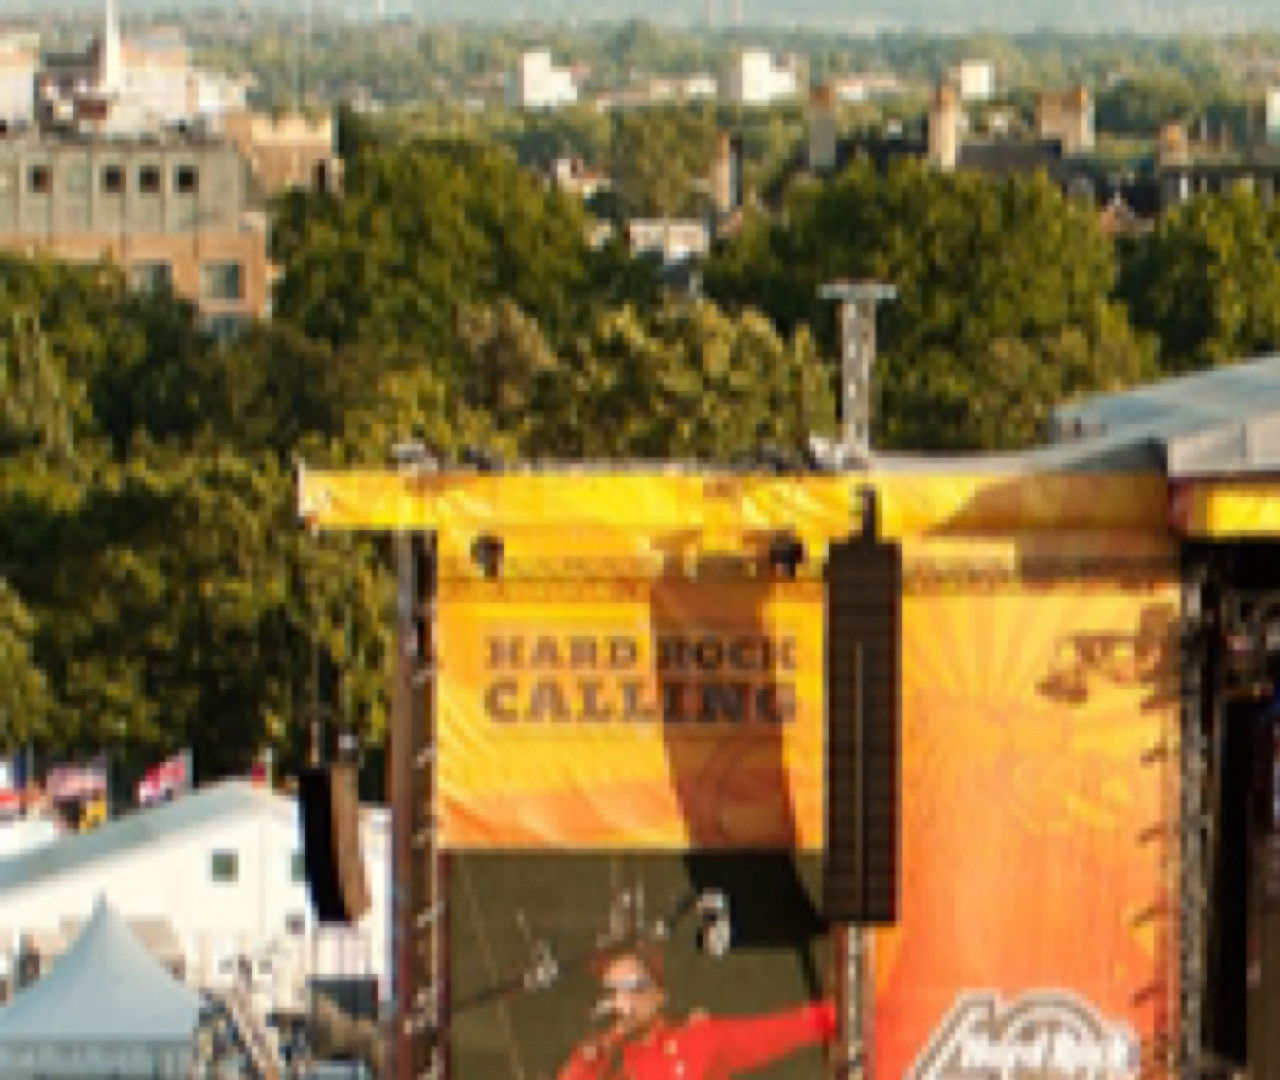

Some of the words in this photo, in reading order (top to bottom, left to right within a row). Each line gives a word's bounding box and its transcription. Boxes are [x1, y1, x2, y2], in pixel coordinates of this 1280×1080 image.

[484, 634, 638, 670] HARD
[655, 634, 797, 670] ROCK
[483, 675, 797, 724] CALLING
